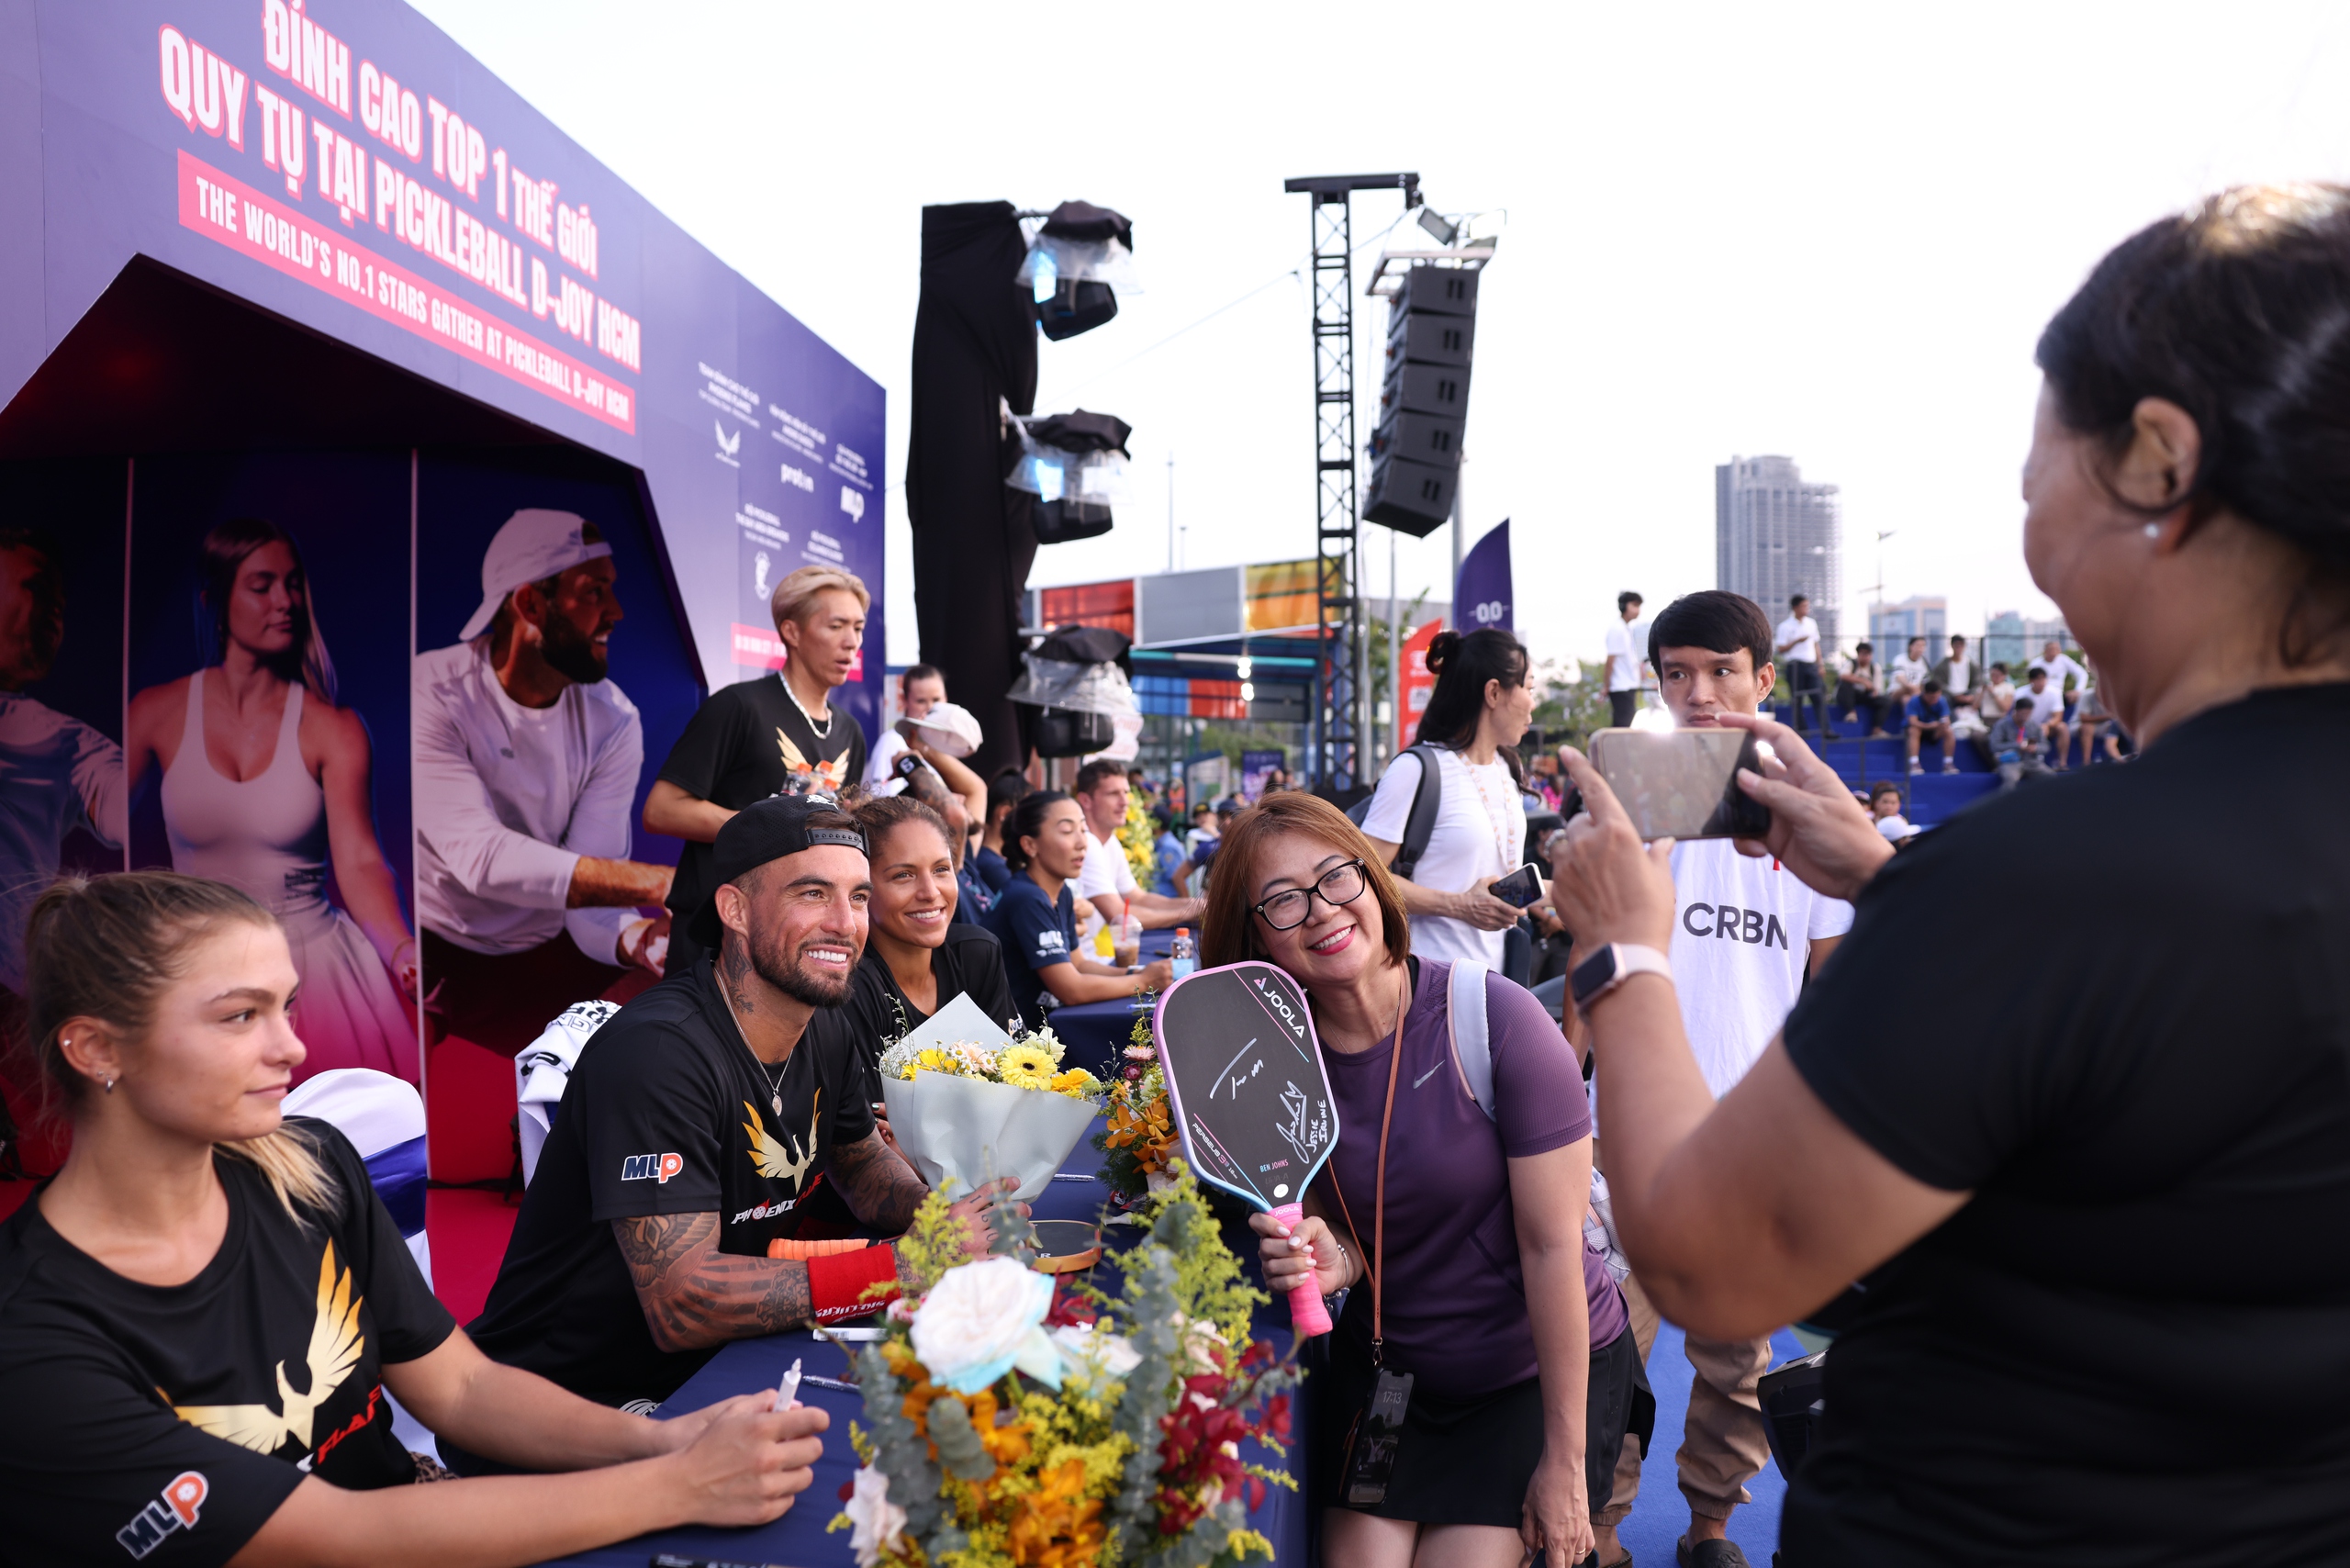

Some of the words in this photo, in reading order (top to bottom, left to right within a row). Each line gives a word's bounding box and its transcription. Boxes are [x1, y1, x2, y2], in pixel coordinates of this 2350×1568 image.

[360, 62, 420, 157] CAO
[428, 95, 487, 197] TOP
[493, 149, 507, 218] 1
[512, 167, 557, 248] THẾ
[162, 28, 245, 144] QUY
[257, 84, 304, 194] TỤ
[314, 120, 366, 221] TẠI
[375, 159, 527, 306] PICKLEBALL
[532, 256, 595, 343] D-JOY
[599, 298, 640, 369] HCM
[196, 175, 238, 233] THE
[243, 200, 331, 277] WORLD'S
[337, 248, 374, 298] NO.1
[378, 271, 427, 324] STARS
[431, 298, 483, 352] GATHER
[487, 325, 502, 361] AT
[506, 336, 571, 395] PICKLEBALL
[574, 370, 605, 410] D-JOY
[607, 386, 629, 421] HCM
[1683, 902, 1788, 951] CRBN
[1263, 990, 1304, 1038] JOOLA
[621, 1152, 683, 1184] MLP
[1259, 1163, 1271, 1173] BEN
[1271, 1159, 1289, 1170] JOHNS
[1274, 1205, 1300, 1217] JOOLA
[1383, 1391, 1403, 1405] 17:13
[116, 1471, 209, 1561] MLP
